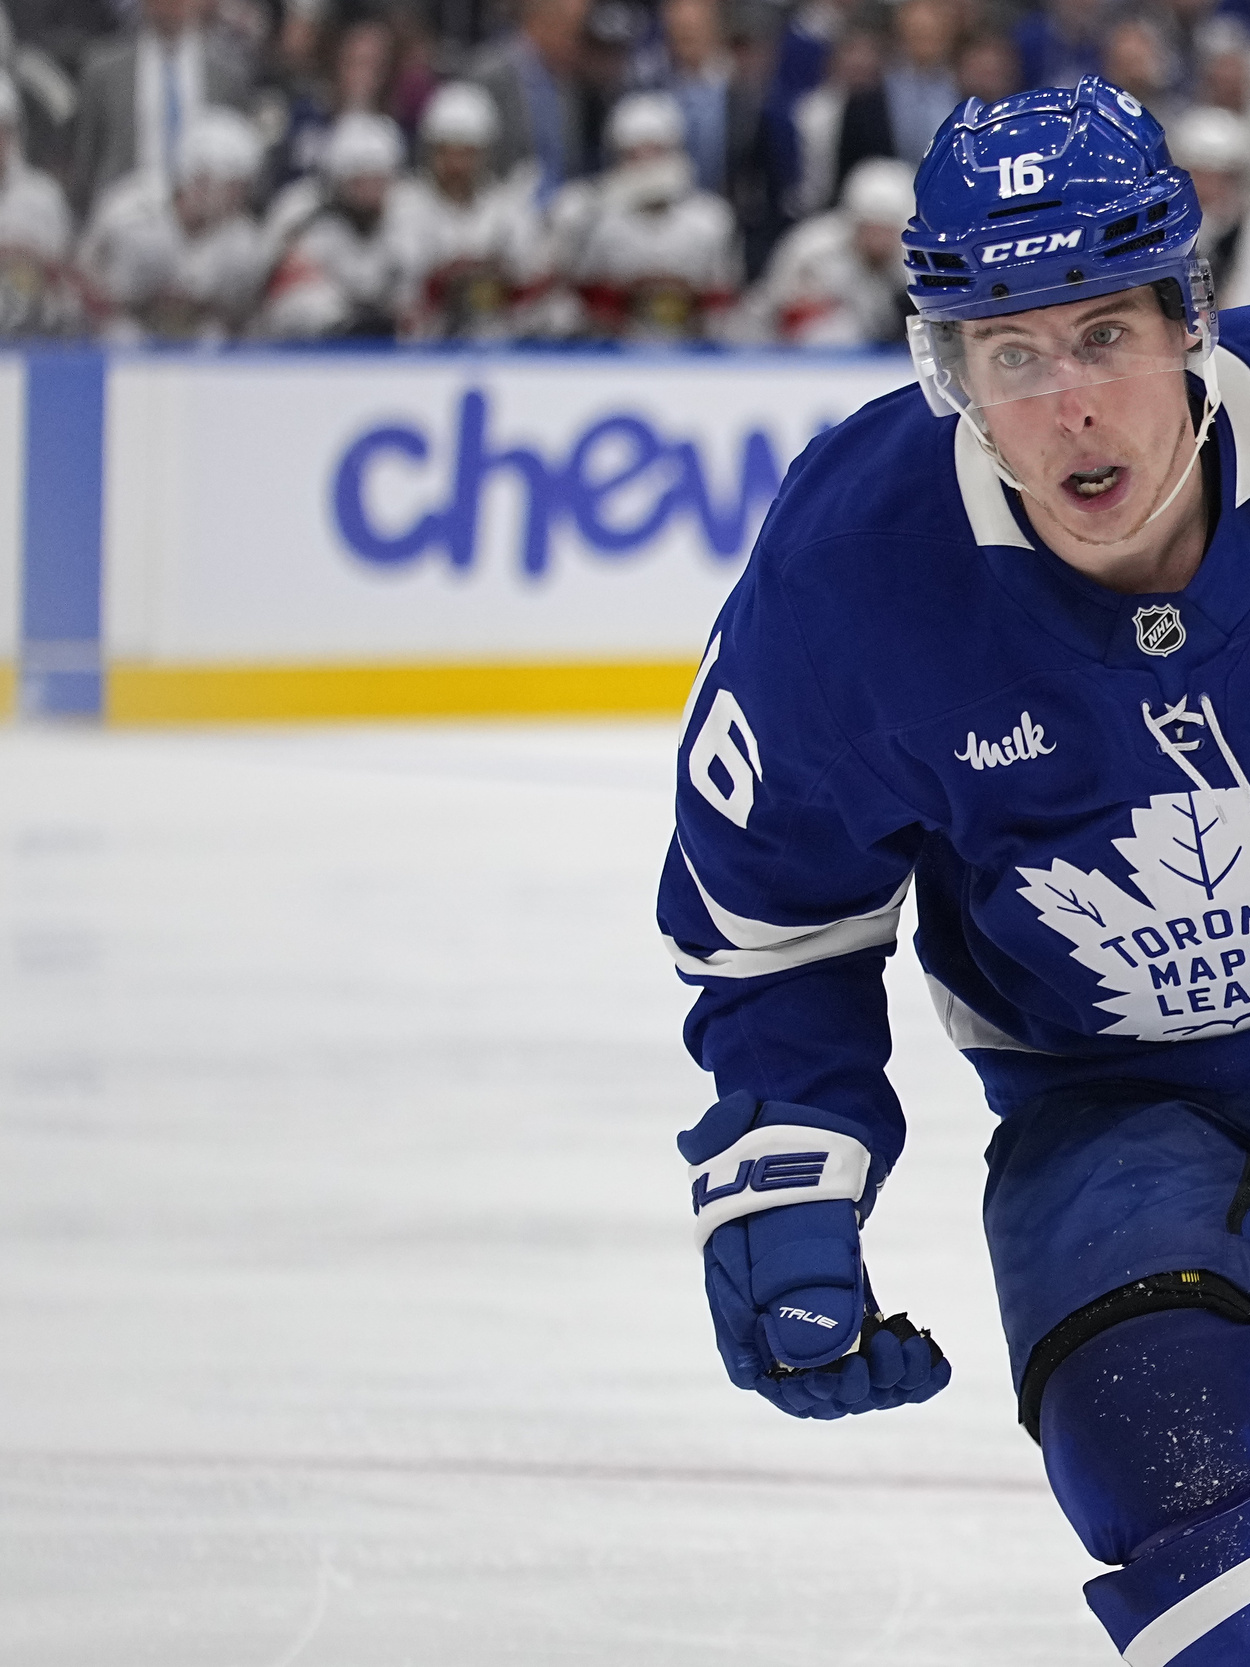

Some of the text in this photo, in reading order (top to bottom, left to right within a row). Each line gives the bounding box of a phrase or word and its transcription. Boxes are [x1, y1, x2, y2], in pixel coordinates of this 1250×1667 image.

[999, 152, 1044, 199] 16
[981, 227, 1084, 265] CCM
[333, 390, 790, 576] chew
[1147, 616, 1173, 647] NHL
[678, 630, 763, 829] 16
[693, 1151, 830, 1215] UE
[778, 1306, 839, 1330] TRUE
